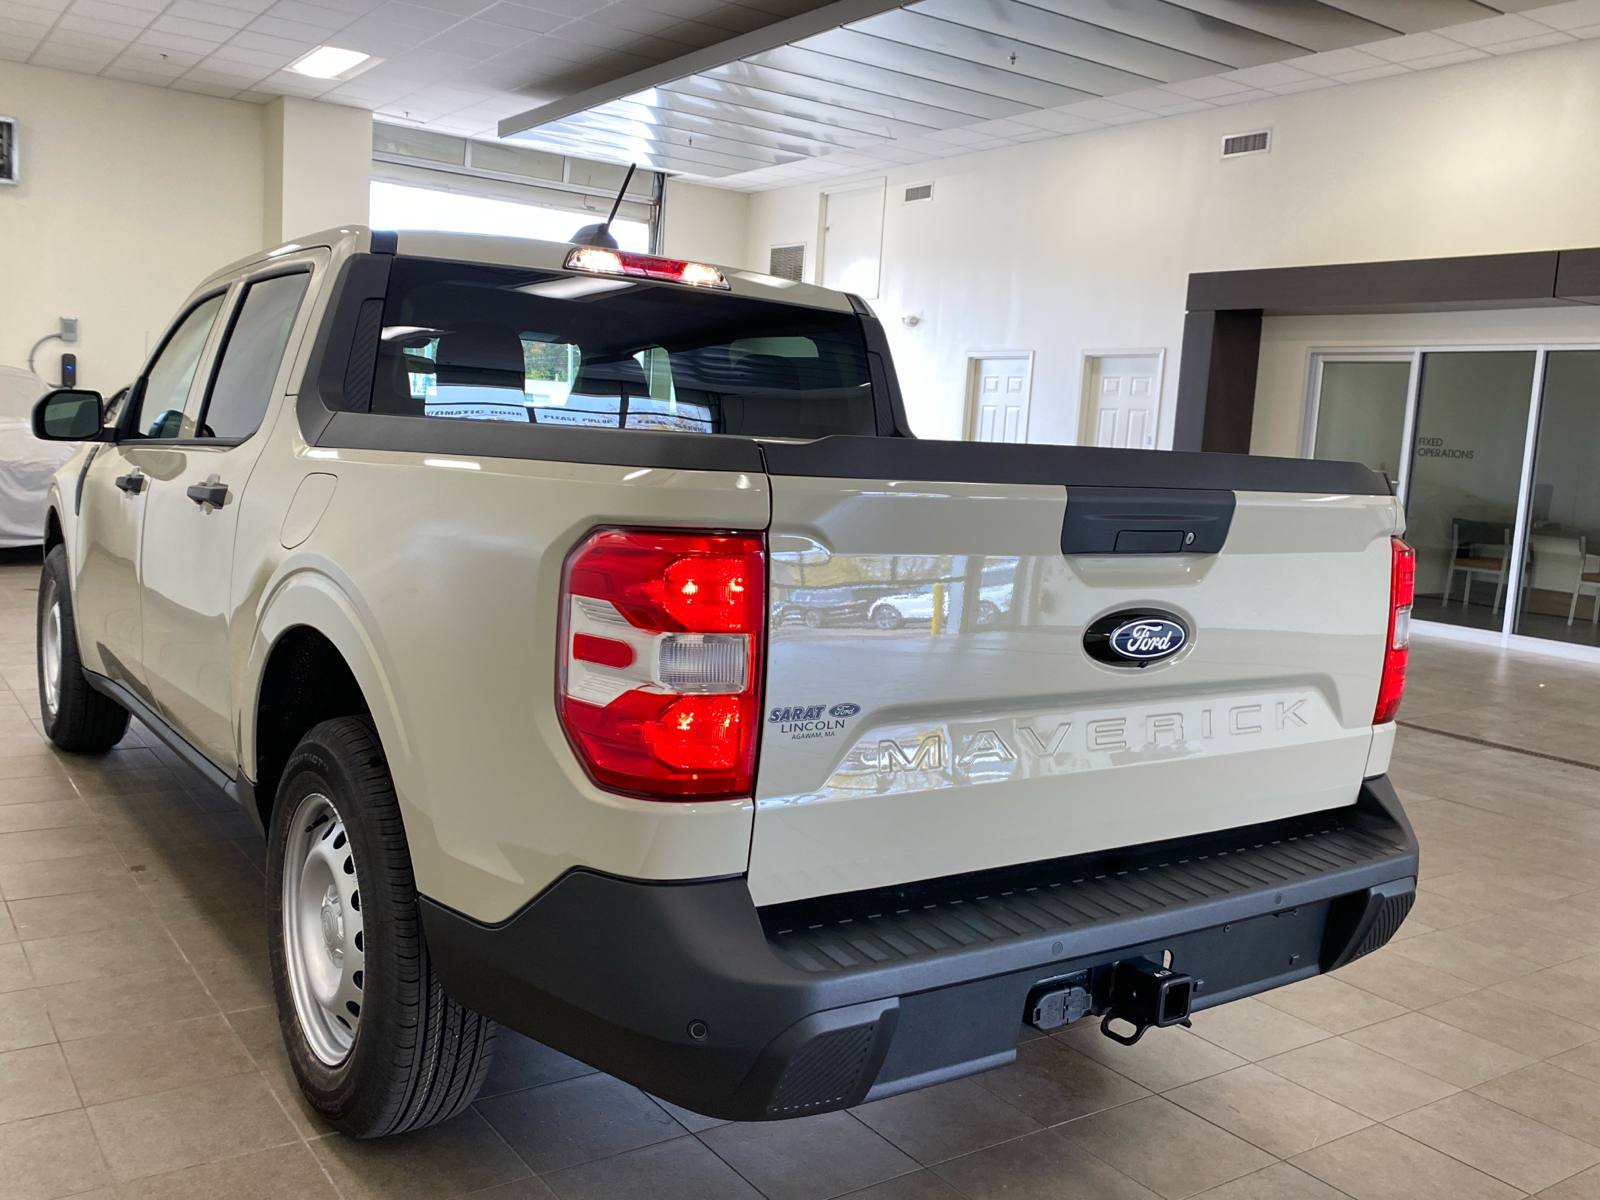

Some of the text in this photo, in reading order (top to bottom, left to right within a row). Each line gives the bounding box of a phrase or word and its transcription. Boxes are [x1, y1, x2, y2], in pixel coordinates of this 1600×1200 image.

[425, 409, 485, 417] UTOMATIC
[543, 414, 577, 422] PLEASE
[1418, 437, 1443, 447] FIXED
[1418, 447, 1474, 459] OPERATIONS
[1125, 623, 1174, 653] Ford
[768, 704, 856, 723] SARAT Ford
[781, 720, 845, 733] LINCOLN
[791, 732, 824, 740] AGAWAM,
[876, 698, 1310, 774] MAVERICK
